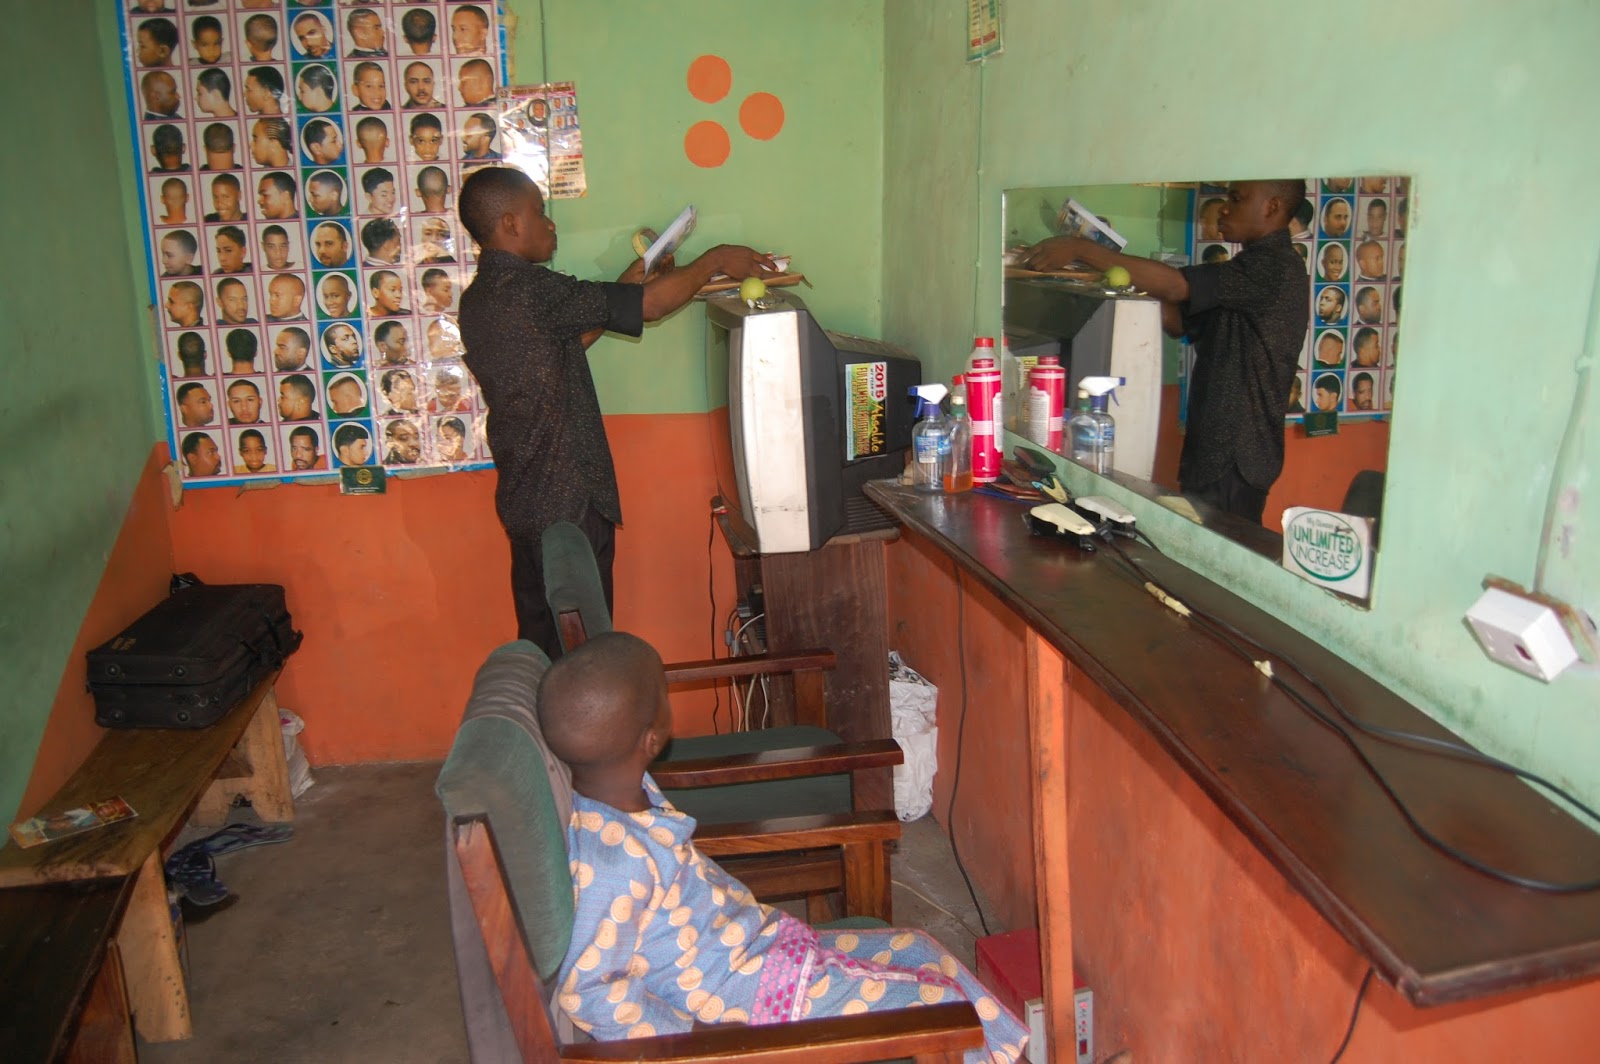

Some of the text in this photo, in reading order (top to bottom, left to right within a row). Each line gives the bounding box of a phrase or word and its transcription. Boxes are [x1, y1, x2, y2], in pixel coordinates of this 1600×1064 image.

[875, 364, 884, 398] 2015
[871, 403, 884, 452] Absolute
[1293, 524, 1353, 554] UNLIMITED
[1296, 543, 1350, 571] INCREASE
